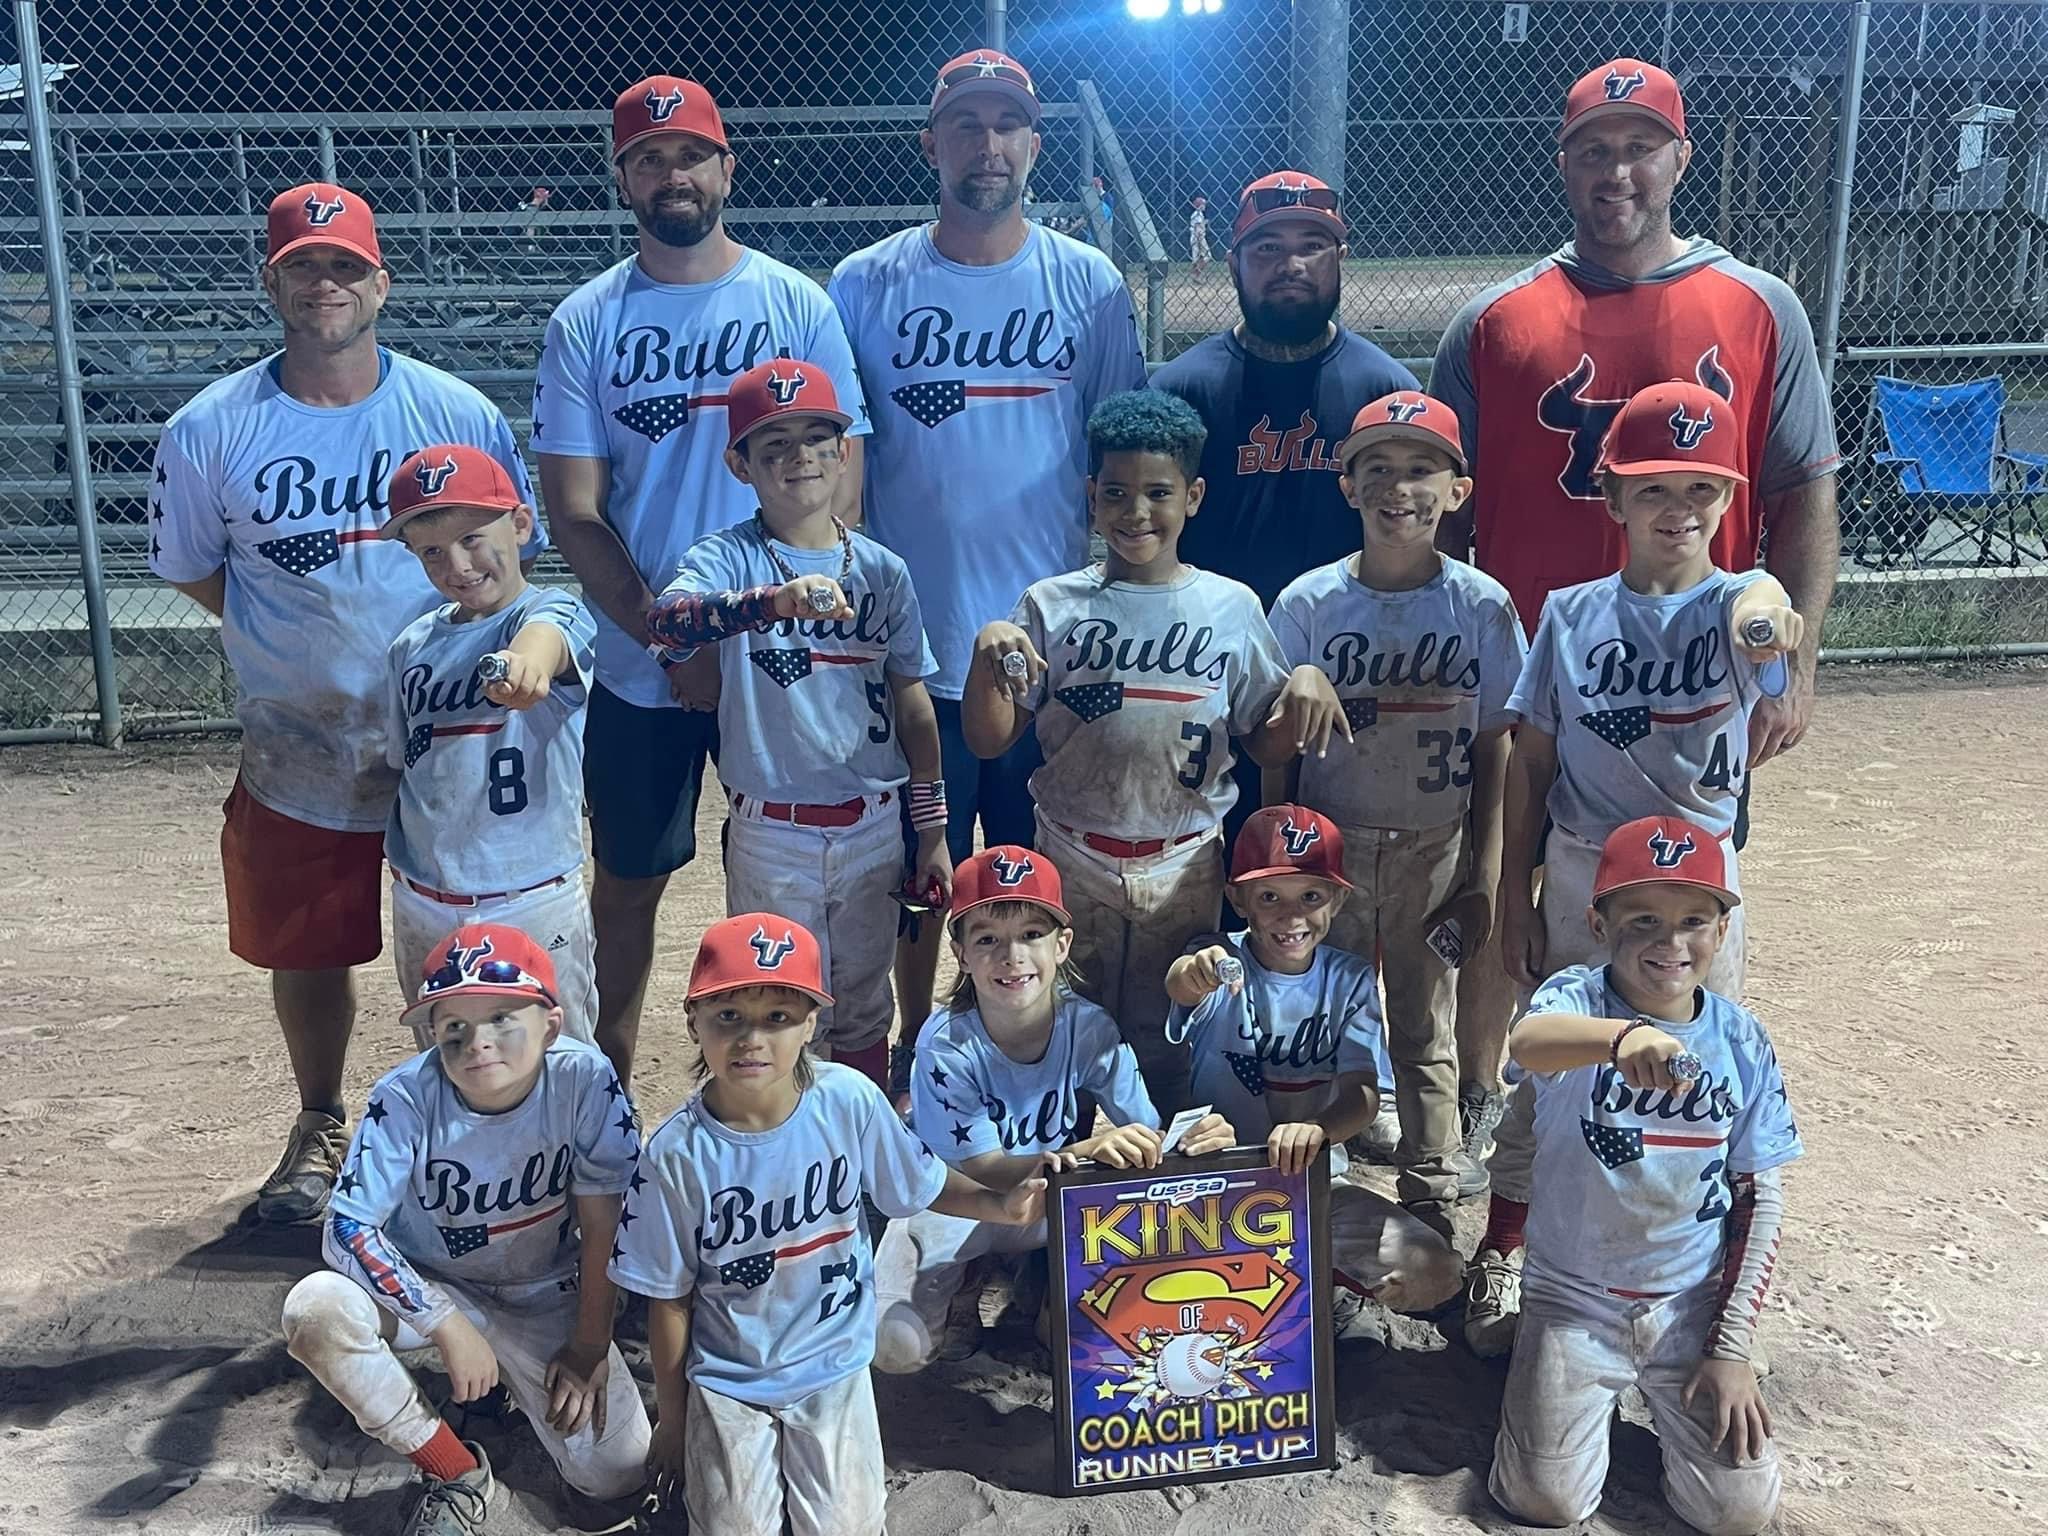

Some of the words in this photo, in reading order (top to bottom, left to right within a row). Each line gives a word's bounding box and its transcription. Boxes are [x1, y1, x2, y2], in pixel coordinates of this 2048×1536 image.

[611, 319, 790, 388] Bull
[892, 306, 1076, 371] Bulls
[252, 448, 420, 525] Bul
[1065, 618, 1230, 681] Bulls
[1322, 631, 1481, 689] Bulls
[1579, 626, 1728, 698] Bull
[401, 663, 506, 720] Bul
[864, 680, 891, 743] 5
[488, 746, 529, 816] 8
[1177, 720, 1212, 789] 3
[1416, 727, 1473, 793] 33
[1698, 732, 1741, 791] 4
[418, 1143, 572, 1216] Bull
[702, 1154, 863, 1250] Bull
[1080, 1189, 1296, 1265] KING
[1179, 1304, 1205, 1330] OF
[1079, 1405, 1202, 1452] COACH
[1216, 1391, 1310, 1441] PITCH
[1077, 1434, 1312, 1485] RUNNER-UP
